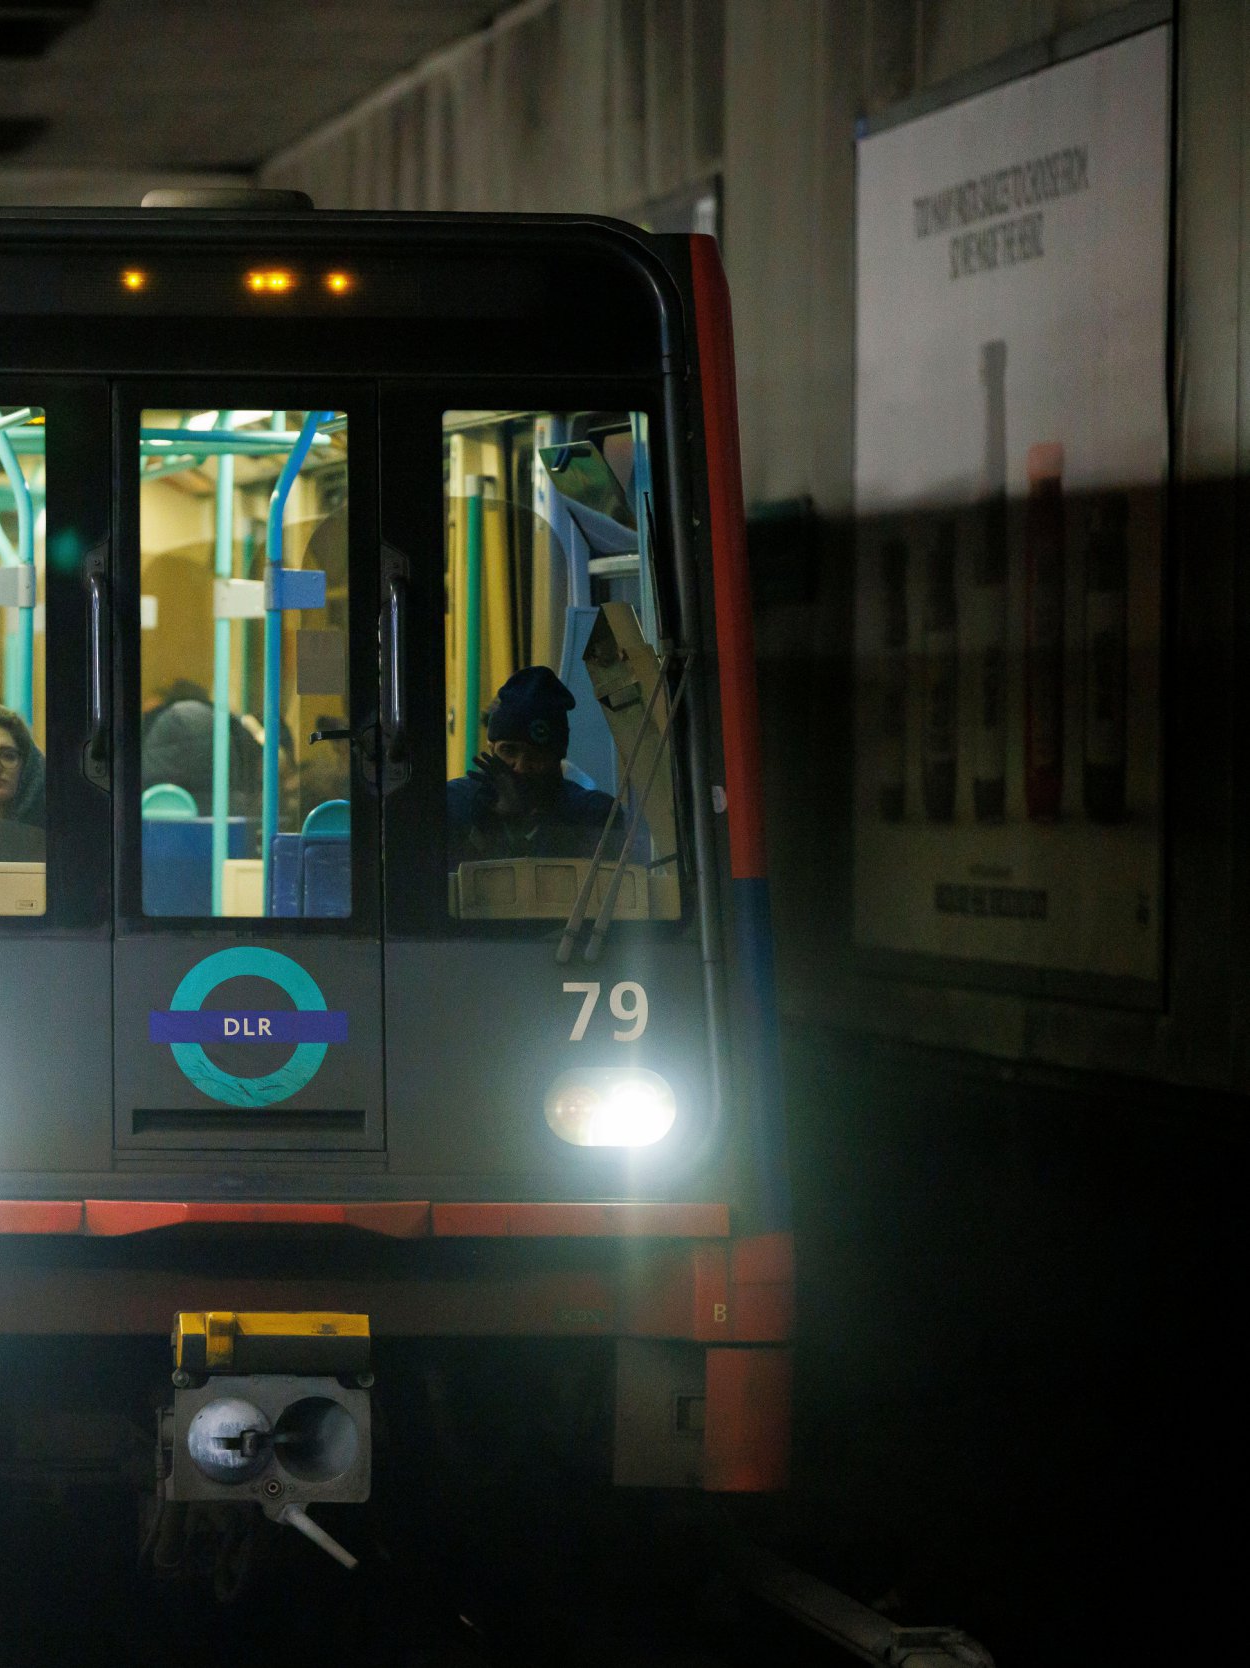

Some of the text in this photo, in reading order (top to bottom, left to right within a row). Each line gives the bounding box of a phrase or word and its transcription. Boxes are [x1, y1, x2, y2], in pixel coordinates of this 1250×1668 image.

[562, 981, 649, 1042] 79
[224, 1018, 272, 1036] DLR
[714, 1303, 727, 1321] B
